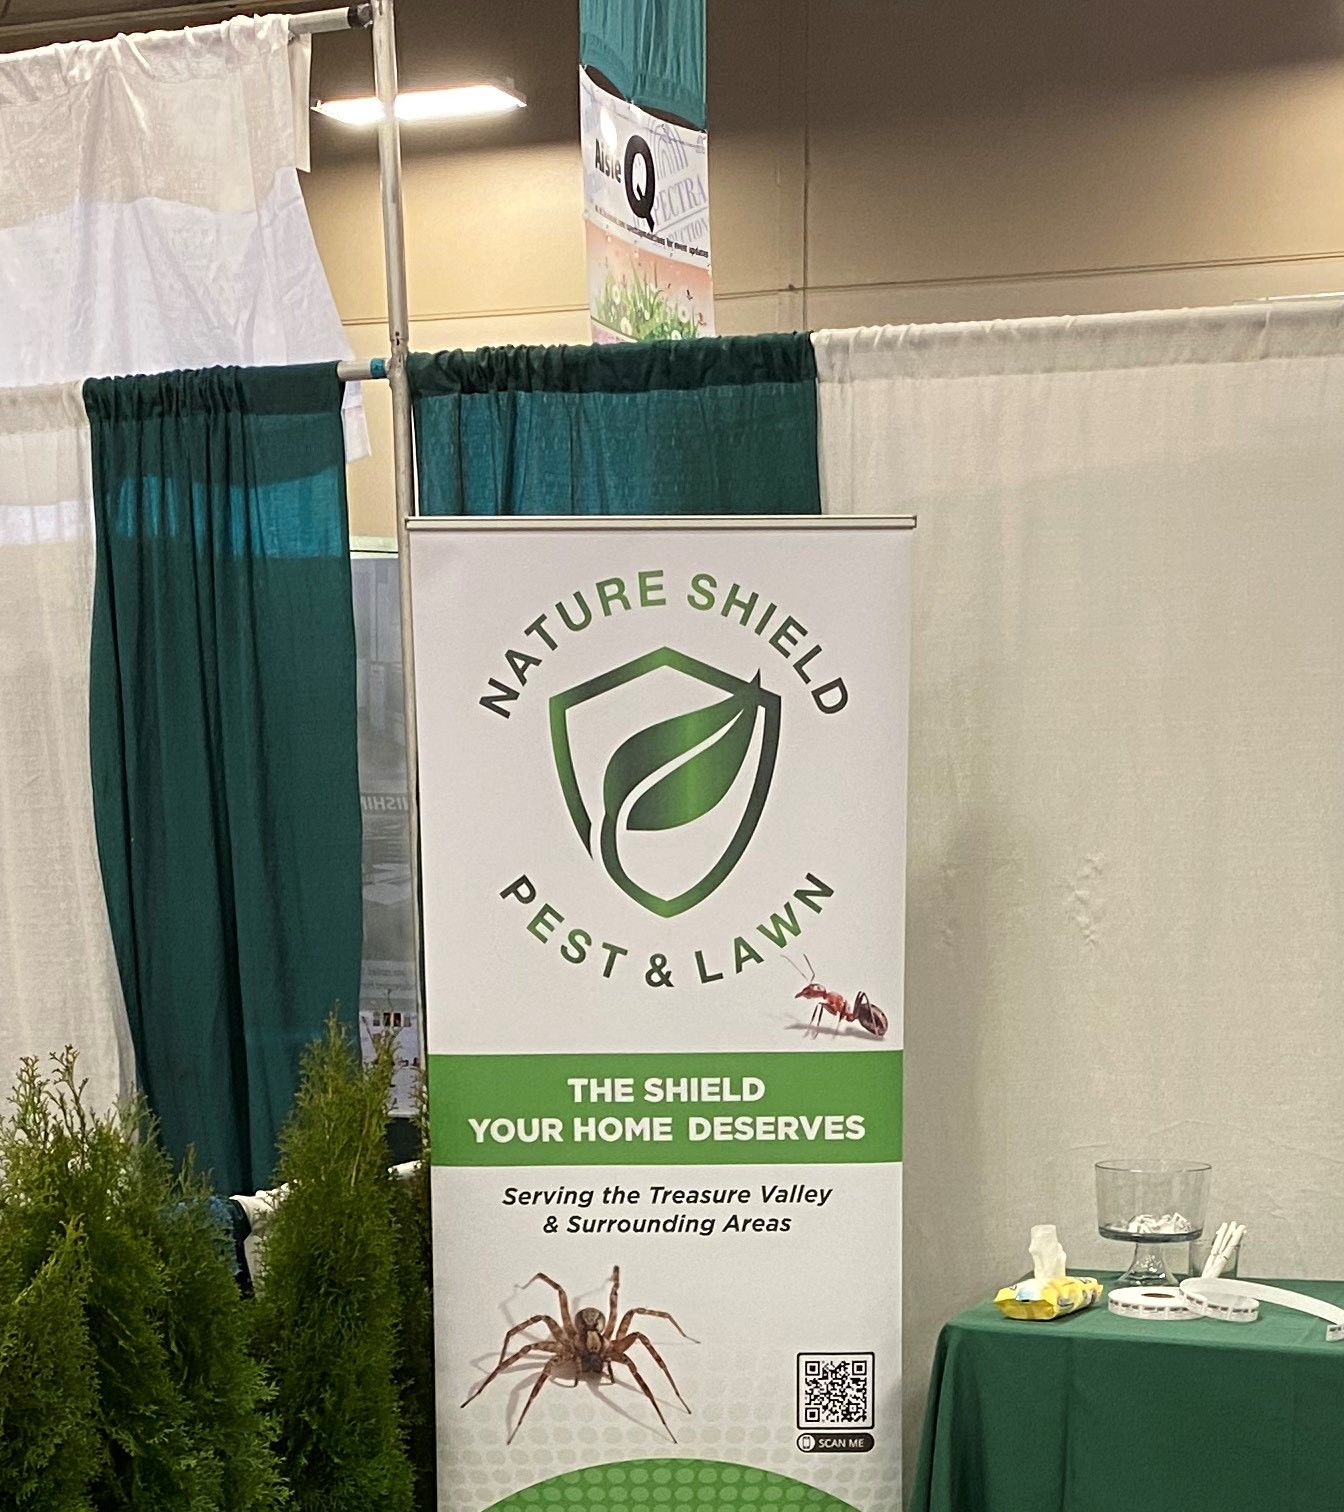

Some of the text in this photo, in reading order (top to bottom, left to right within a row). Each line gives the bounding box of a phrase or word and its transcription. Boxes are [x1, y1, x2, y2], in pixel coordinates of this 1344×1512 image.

[594, 138, 622, 184] Aisle
[624, 134, 656, 233] Q
[478, 569, 849, 718] NATURE SHIELD
[500, 872, 835, 988] PEST & LAWN
[568, 1077, 765, 1103] THE SHIELD
[468, 1114, 866, 1144] YOUR HOME DESERVES
[503, 1183, 832, 1211] Serving the Treasure Valley
[542, 1213, 791, 1237] & Surrounding Areas
[818, 1437, 865, 1449] SCAN ME
